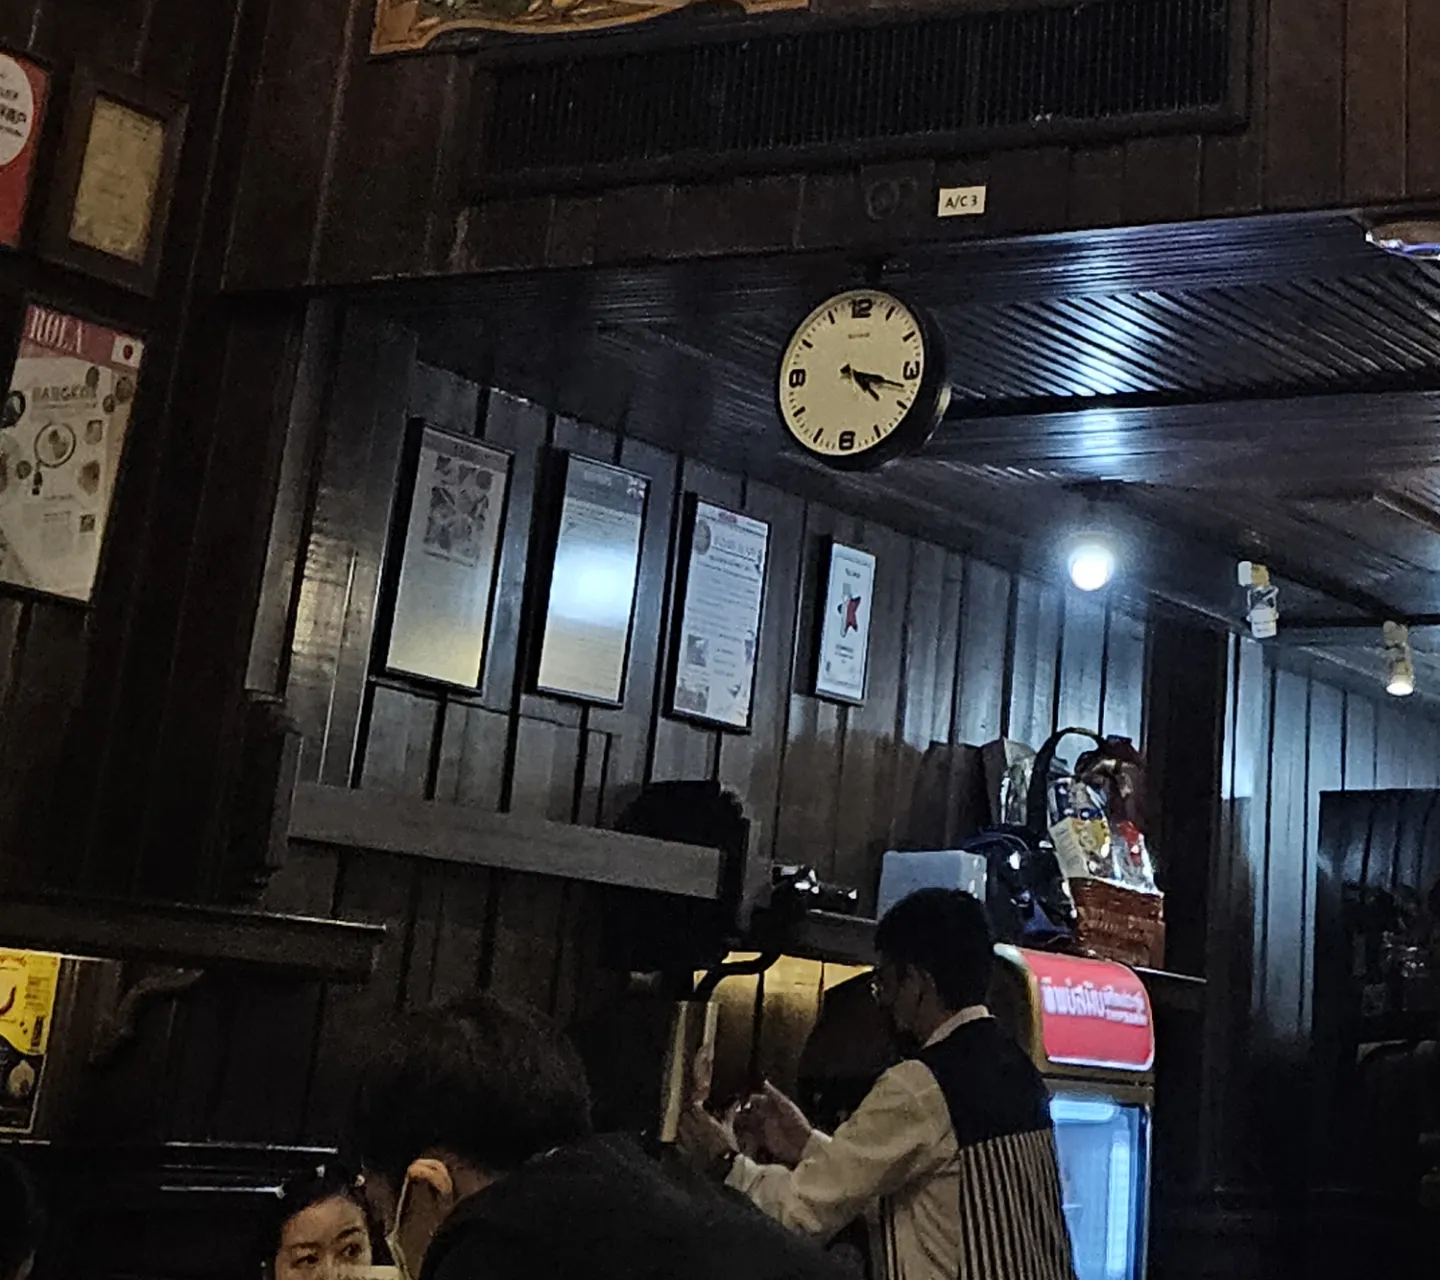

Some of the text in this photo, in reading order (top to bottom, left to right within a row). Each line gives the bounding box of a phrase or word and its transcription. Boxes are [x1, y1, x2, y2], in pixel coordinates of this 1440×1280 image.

[945, 194, 977, 209] A/C 3
[851, 298, 873, 319] 12
[903, 360, 921, 381] 3
